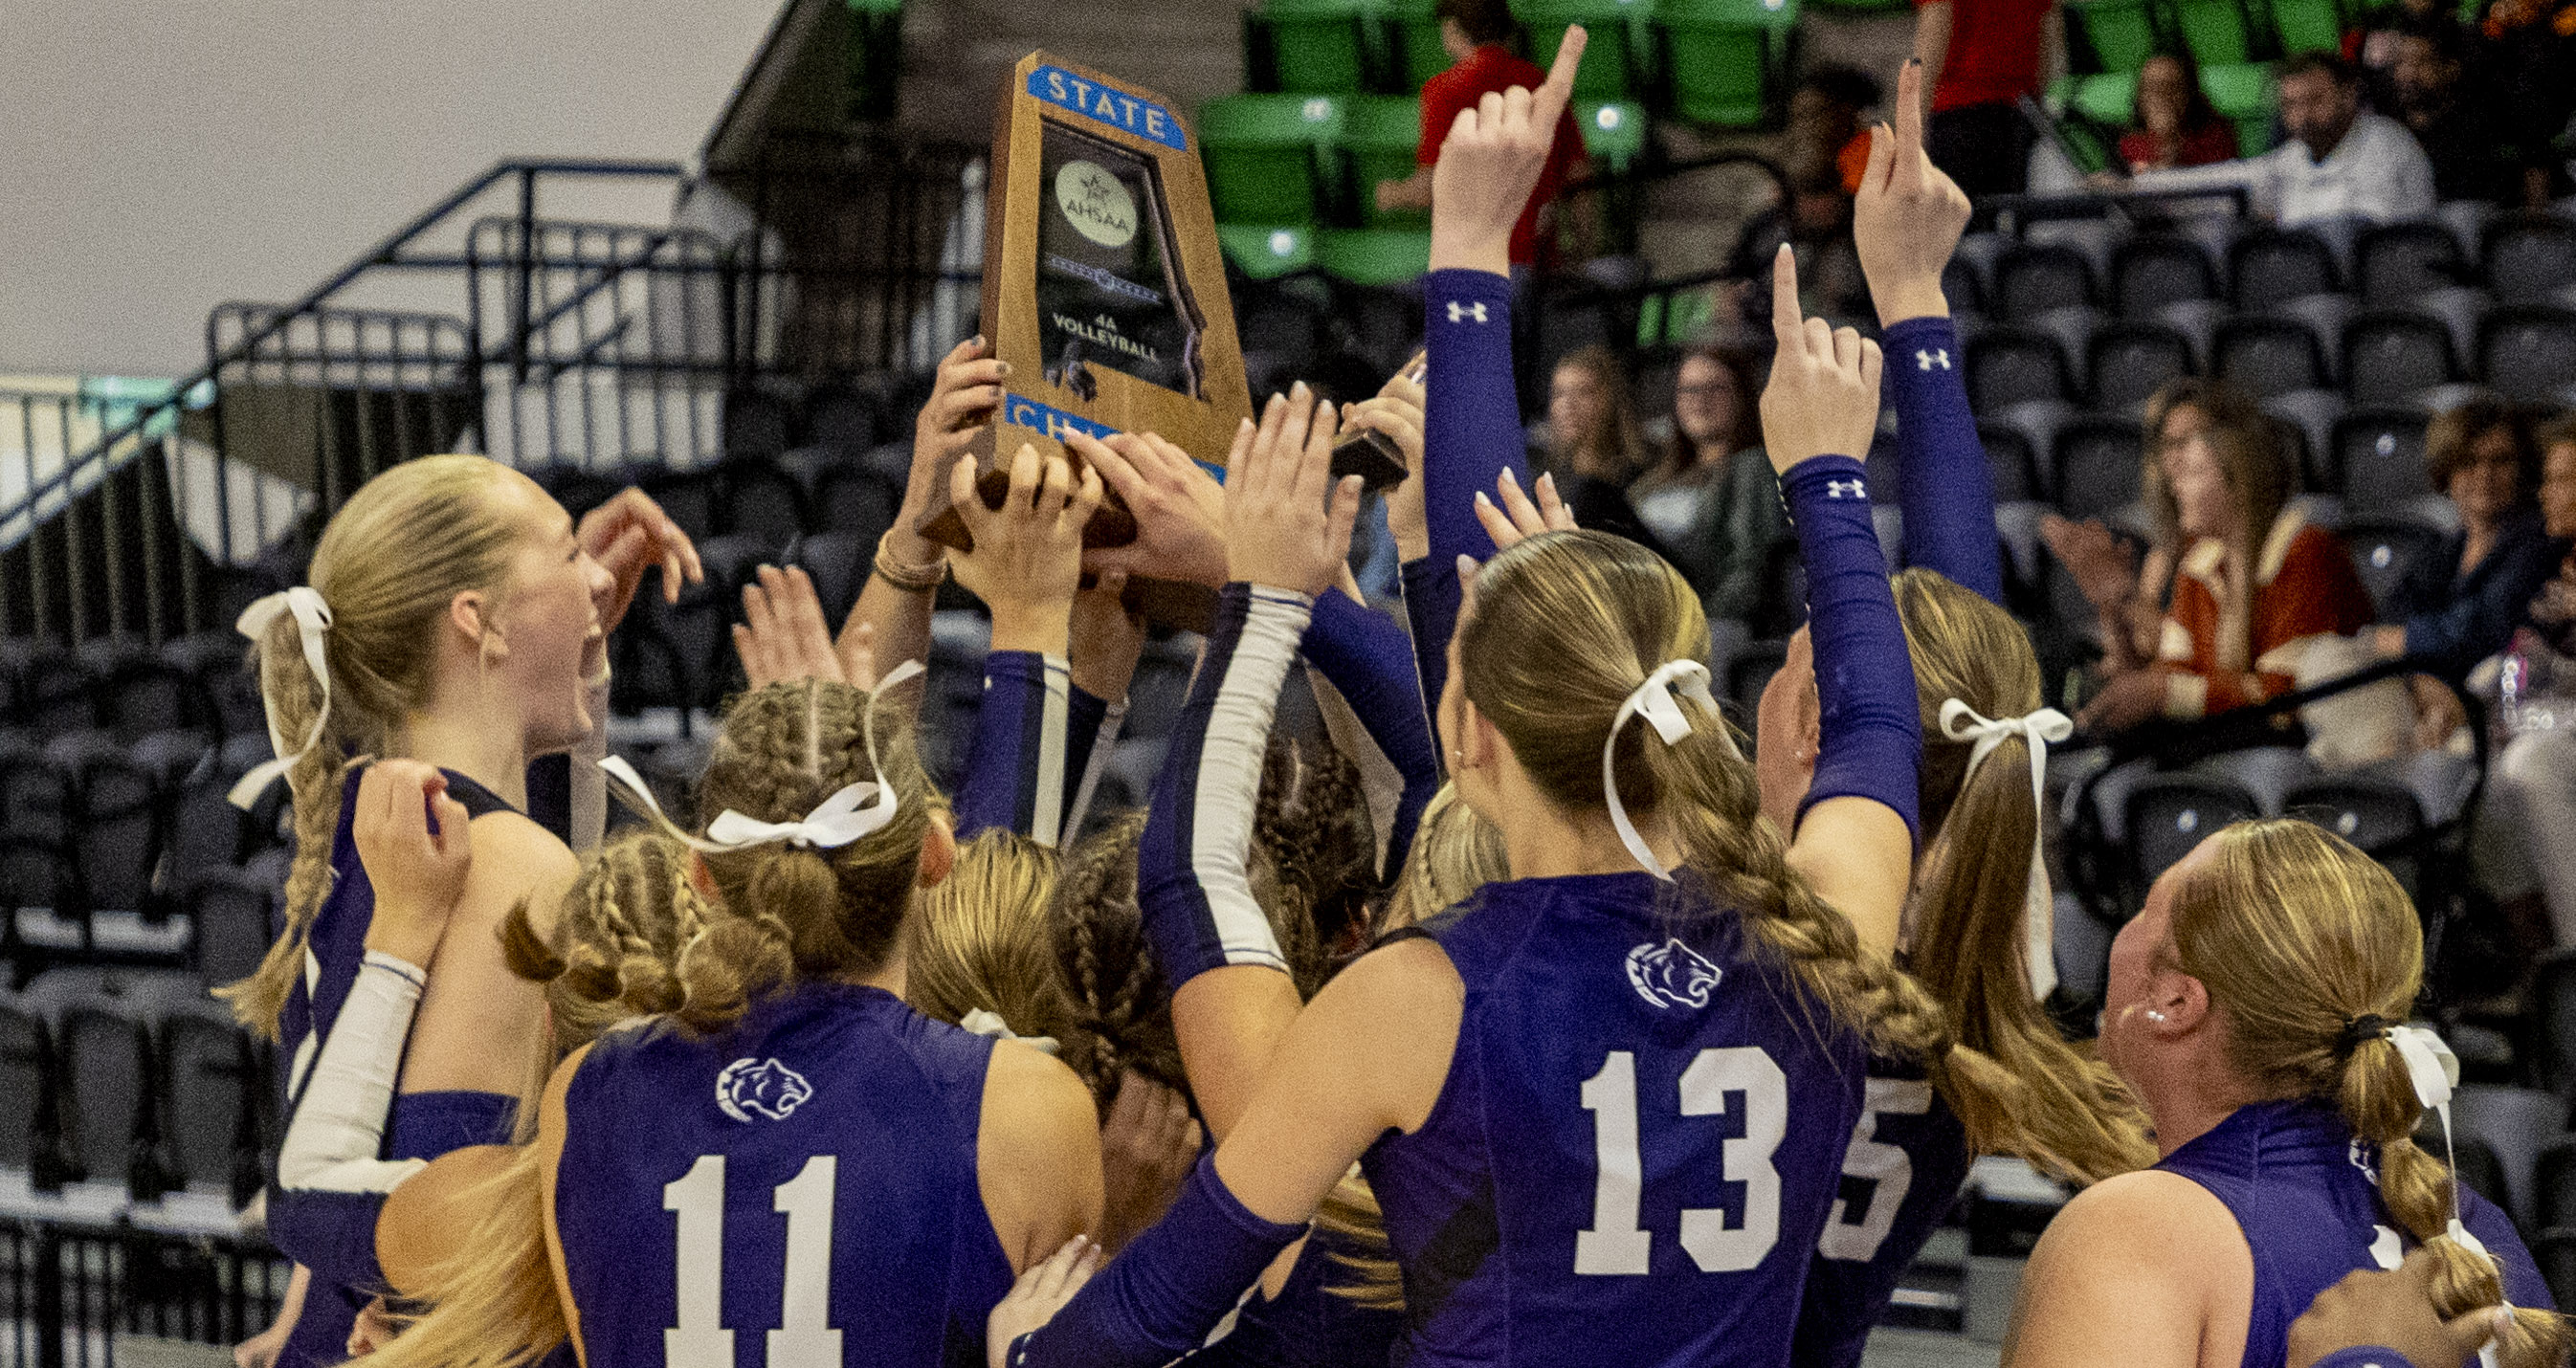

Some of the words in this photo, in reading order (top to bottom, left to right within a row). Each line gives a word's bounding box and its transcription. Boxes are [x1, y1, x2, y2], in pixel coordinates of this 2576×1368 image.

[1048, 72, 1166, 139] STATE
[1067, 199, 1129, 235] AHSAA
[1054, 312, 1159, 364] VOLLEYBALL
[1095, 314, 1118, 332] 4A
[1574, 1047, 1788, 1275] 13
[663, 1155, 843, 1368] 11
